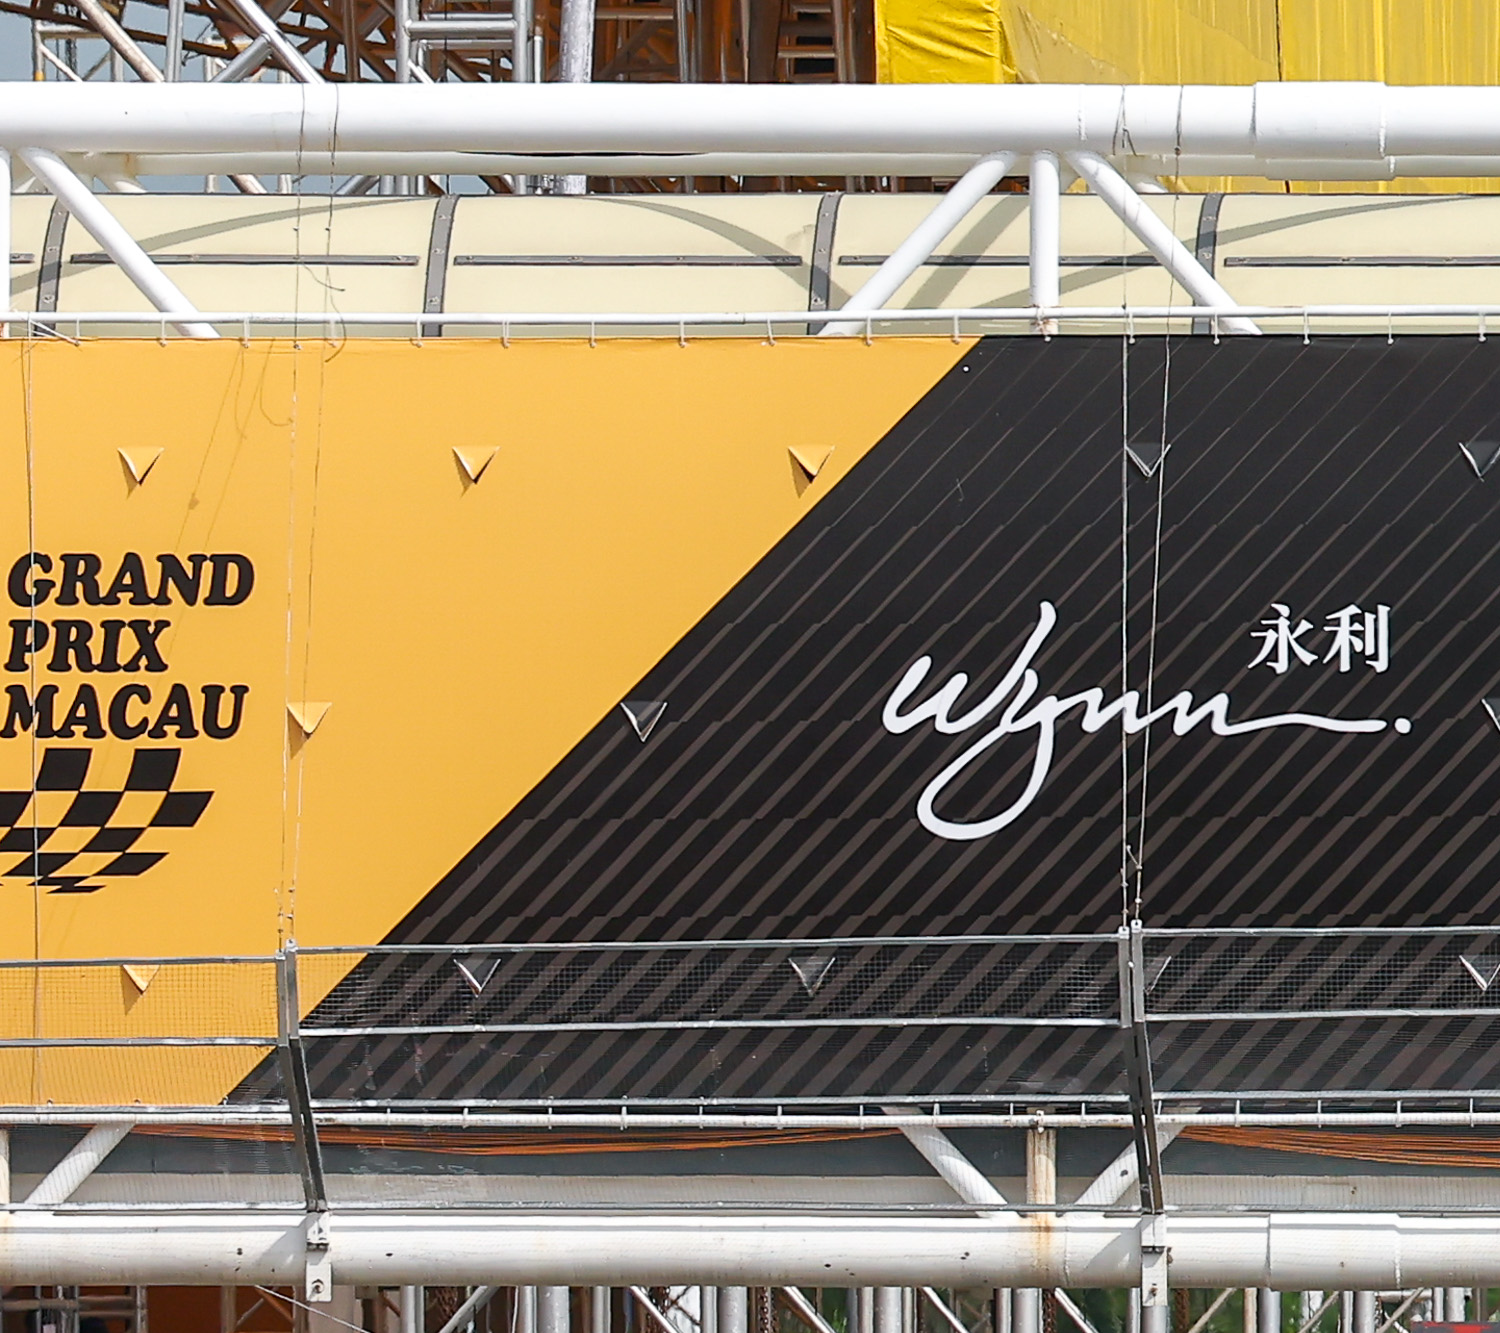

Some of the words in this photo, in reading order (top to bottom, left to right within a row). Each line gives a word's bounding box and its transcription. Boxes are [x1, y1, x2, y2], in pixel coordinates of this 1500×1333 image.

[7, 552, 255, 607] GRAND
[4, 619, 172, 672] PRIX
[1247, 603, 1392, 674] 永利
[0, 683, 249, 740] MACAU
